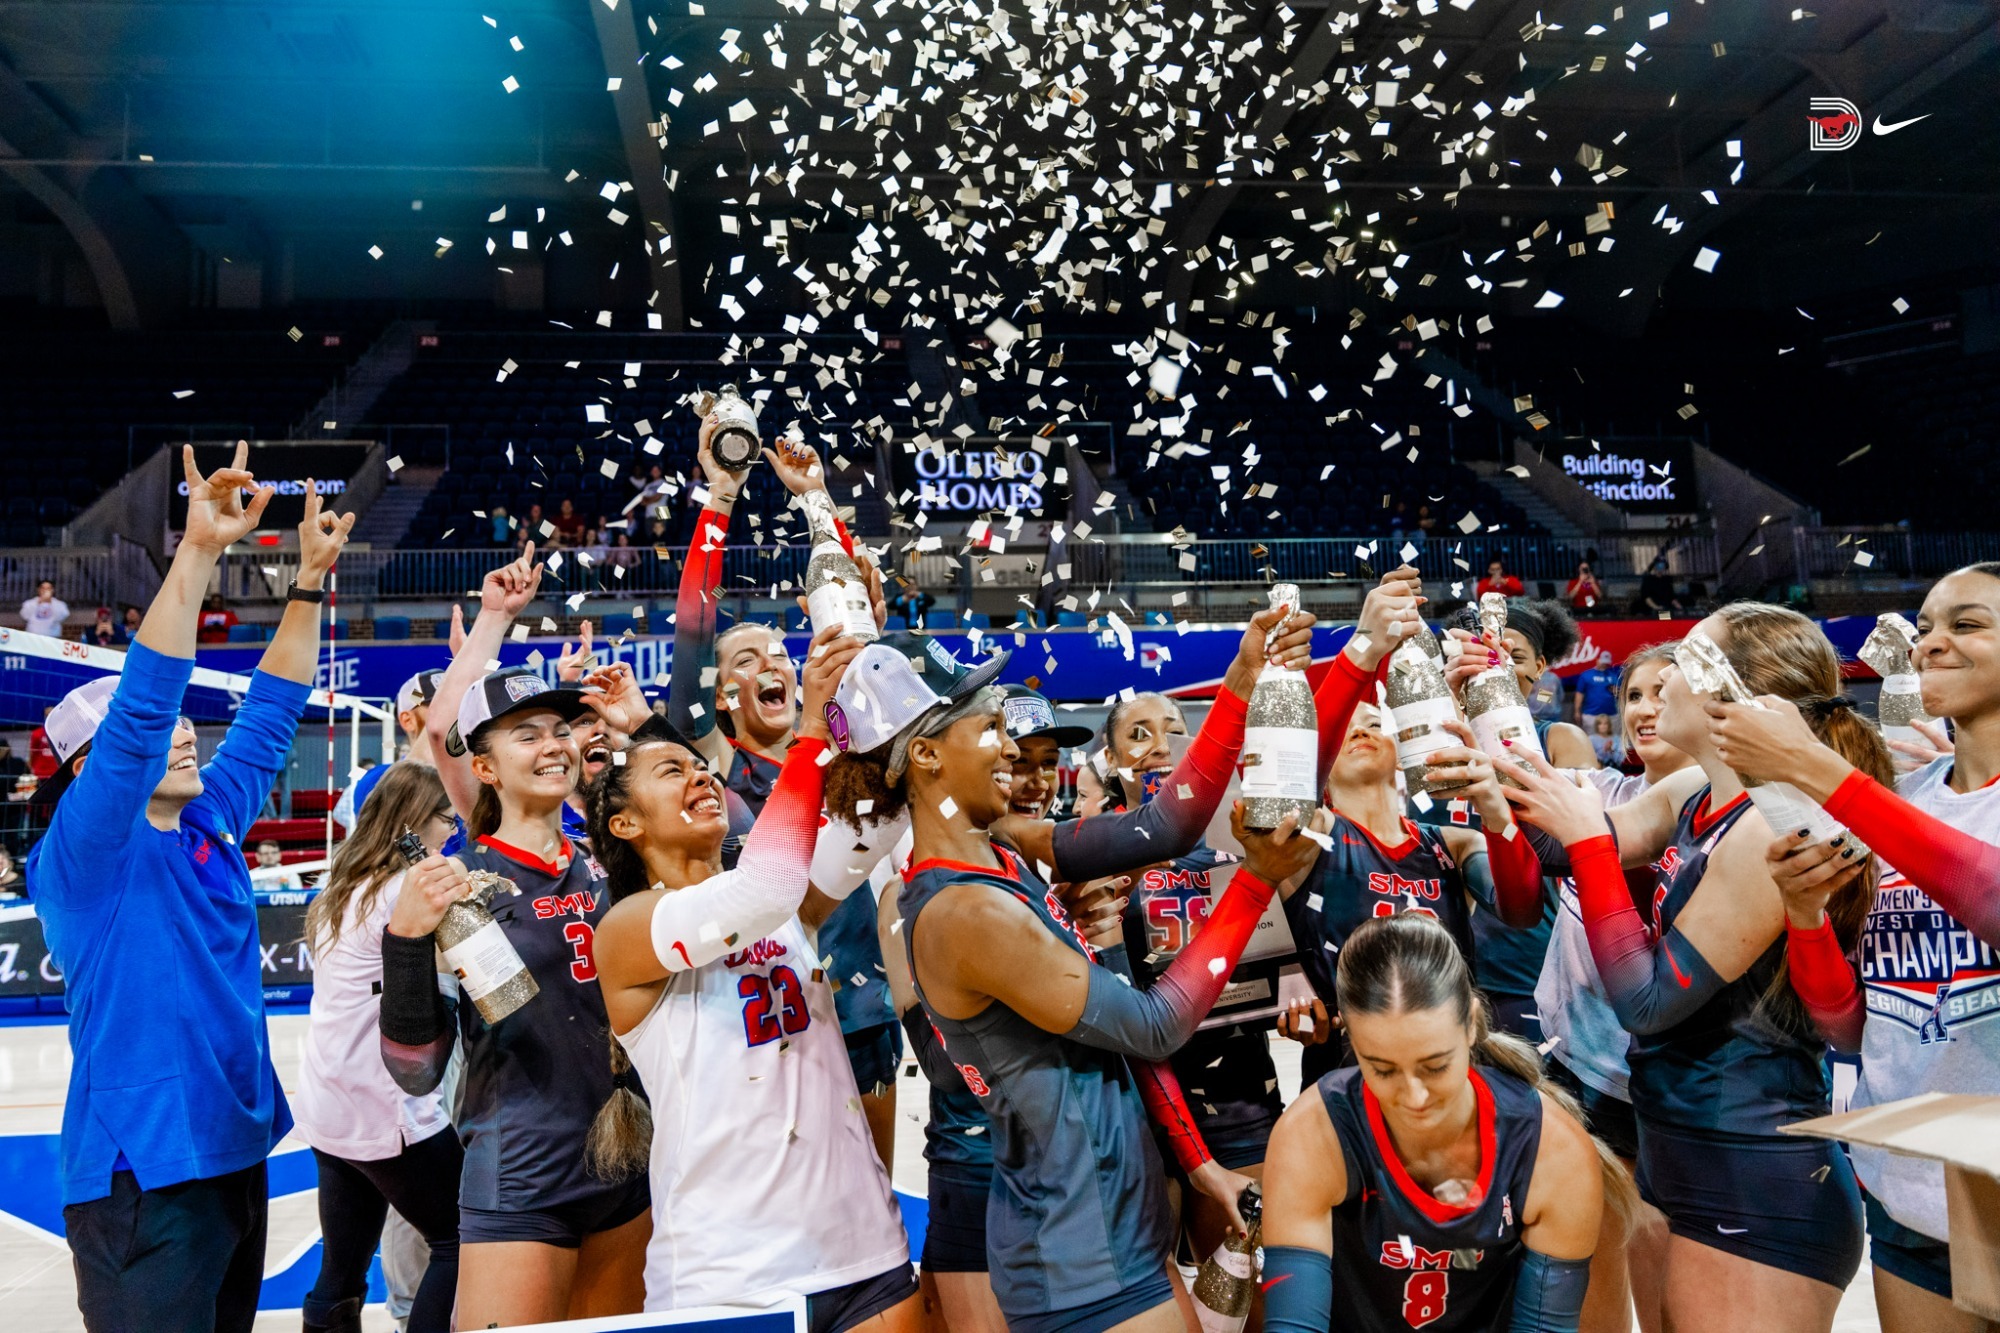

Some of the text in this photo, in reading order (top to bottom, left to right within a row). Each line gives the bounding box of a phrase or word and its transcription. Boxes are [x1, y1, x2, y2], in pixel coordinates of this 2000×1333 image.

[914, 448, 1043, 479] OLERO
[1563, 453, 1644, 479] Building
[915, 479, 1043, 510] HOMES
[63, 641, 89, 659] SMU
[1143, 869, 1211, 891] SMU
[1369, 872, 1441, 901] SMU
[269, 893, 307, 906] UTSW
[532, 891, 597, 919] SMU
[563, 920, 598, 983] 3
[737, 964, 812, 1048] 23
[1866, 990, 1924, 1024] EGULAR
[1380, 1241, 1484, 1269] SM
[1402, 1271, 1449, 1330] 8
